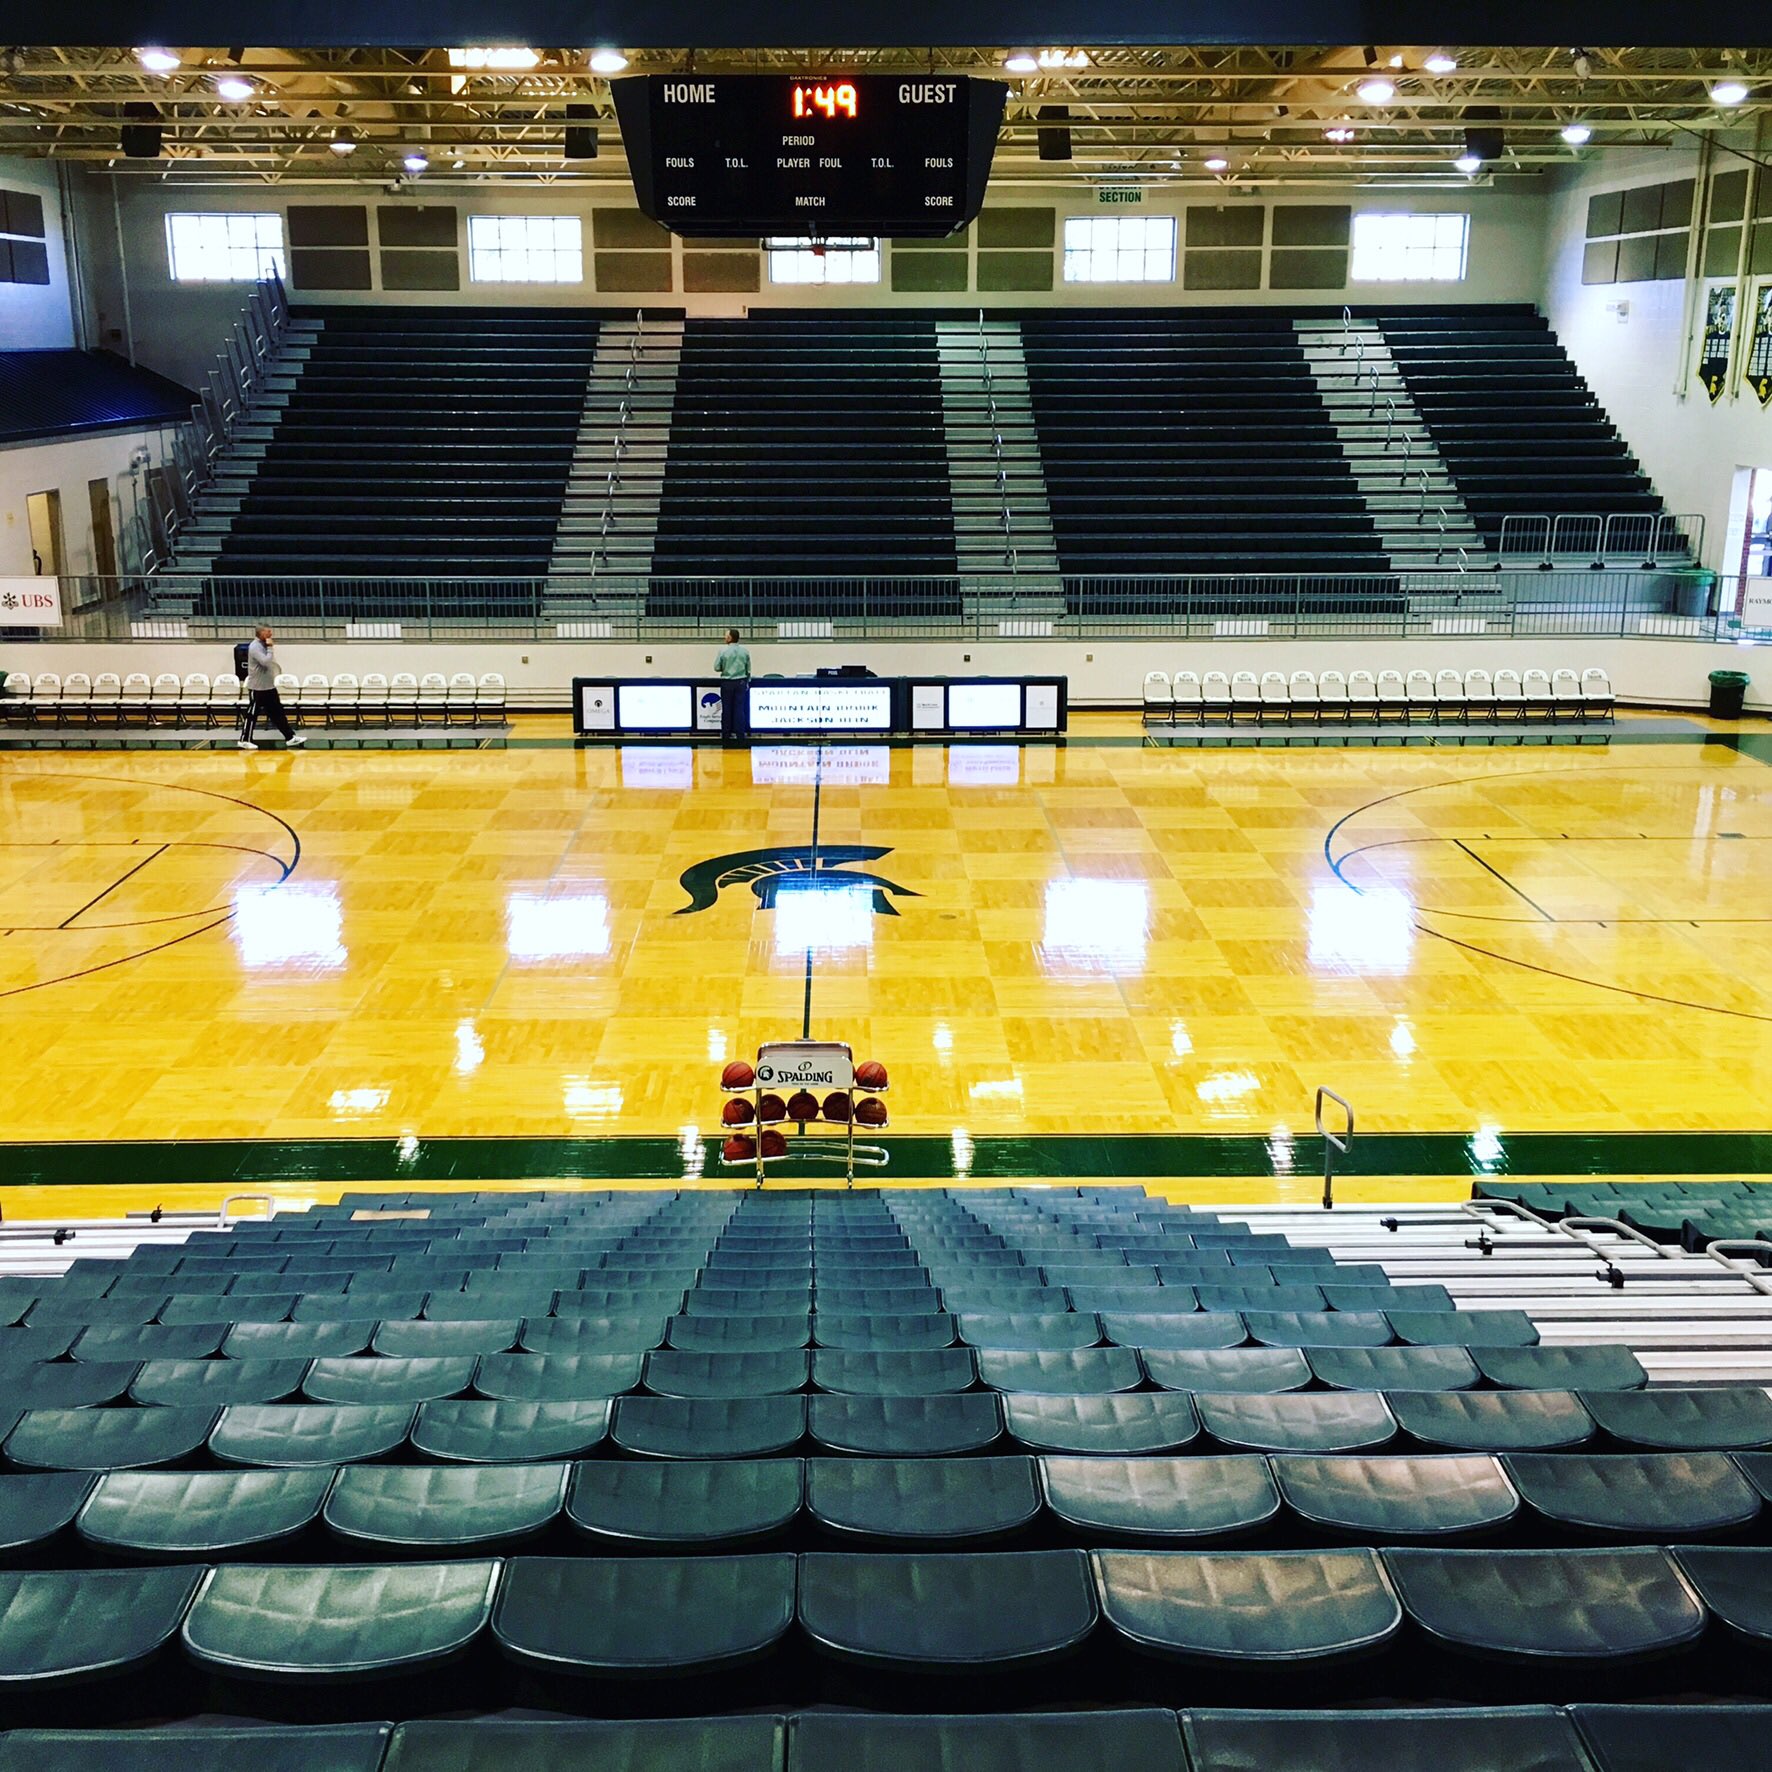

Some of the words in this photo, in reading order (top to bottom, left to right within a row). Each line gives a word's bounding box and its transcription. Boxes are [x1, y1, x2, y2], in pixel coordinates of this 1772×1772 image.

[663, 84, 716, 103] HOME
[898, 84, 957, 103] GUEST
[794, 84, 857, 118] 1:49
[782, 135, 815, 146] PERIOD
[665, 157, 695, 168] FOULS
[725, 157, 749, 168] T.O.L.
[776, 157, 810, 168] PLAYER
[819, 157, 843, 168] FOUL
[871, 157, 895, 168] T.O.L.
[924, 157, 954, 168] FOULS
[667, 196, 697, 206] SCORE
[795, 196, 826, 206] MATCH
[924, 196, 954, 206] SCORE
[1099, 191, 1142, 203] SECTION
[21, 594, 54, 608] UBS
[777, 1070, 833, 1083] SPALDING
